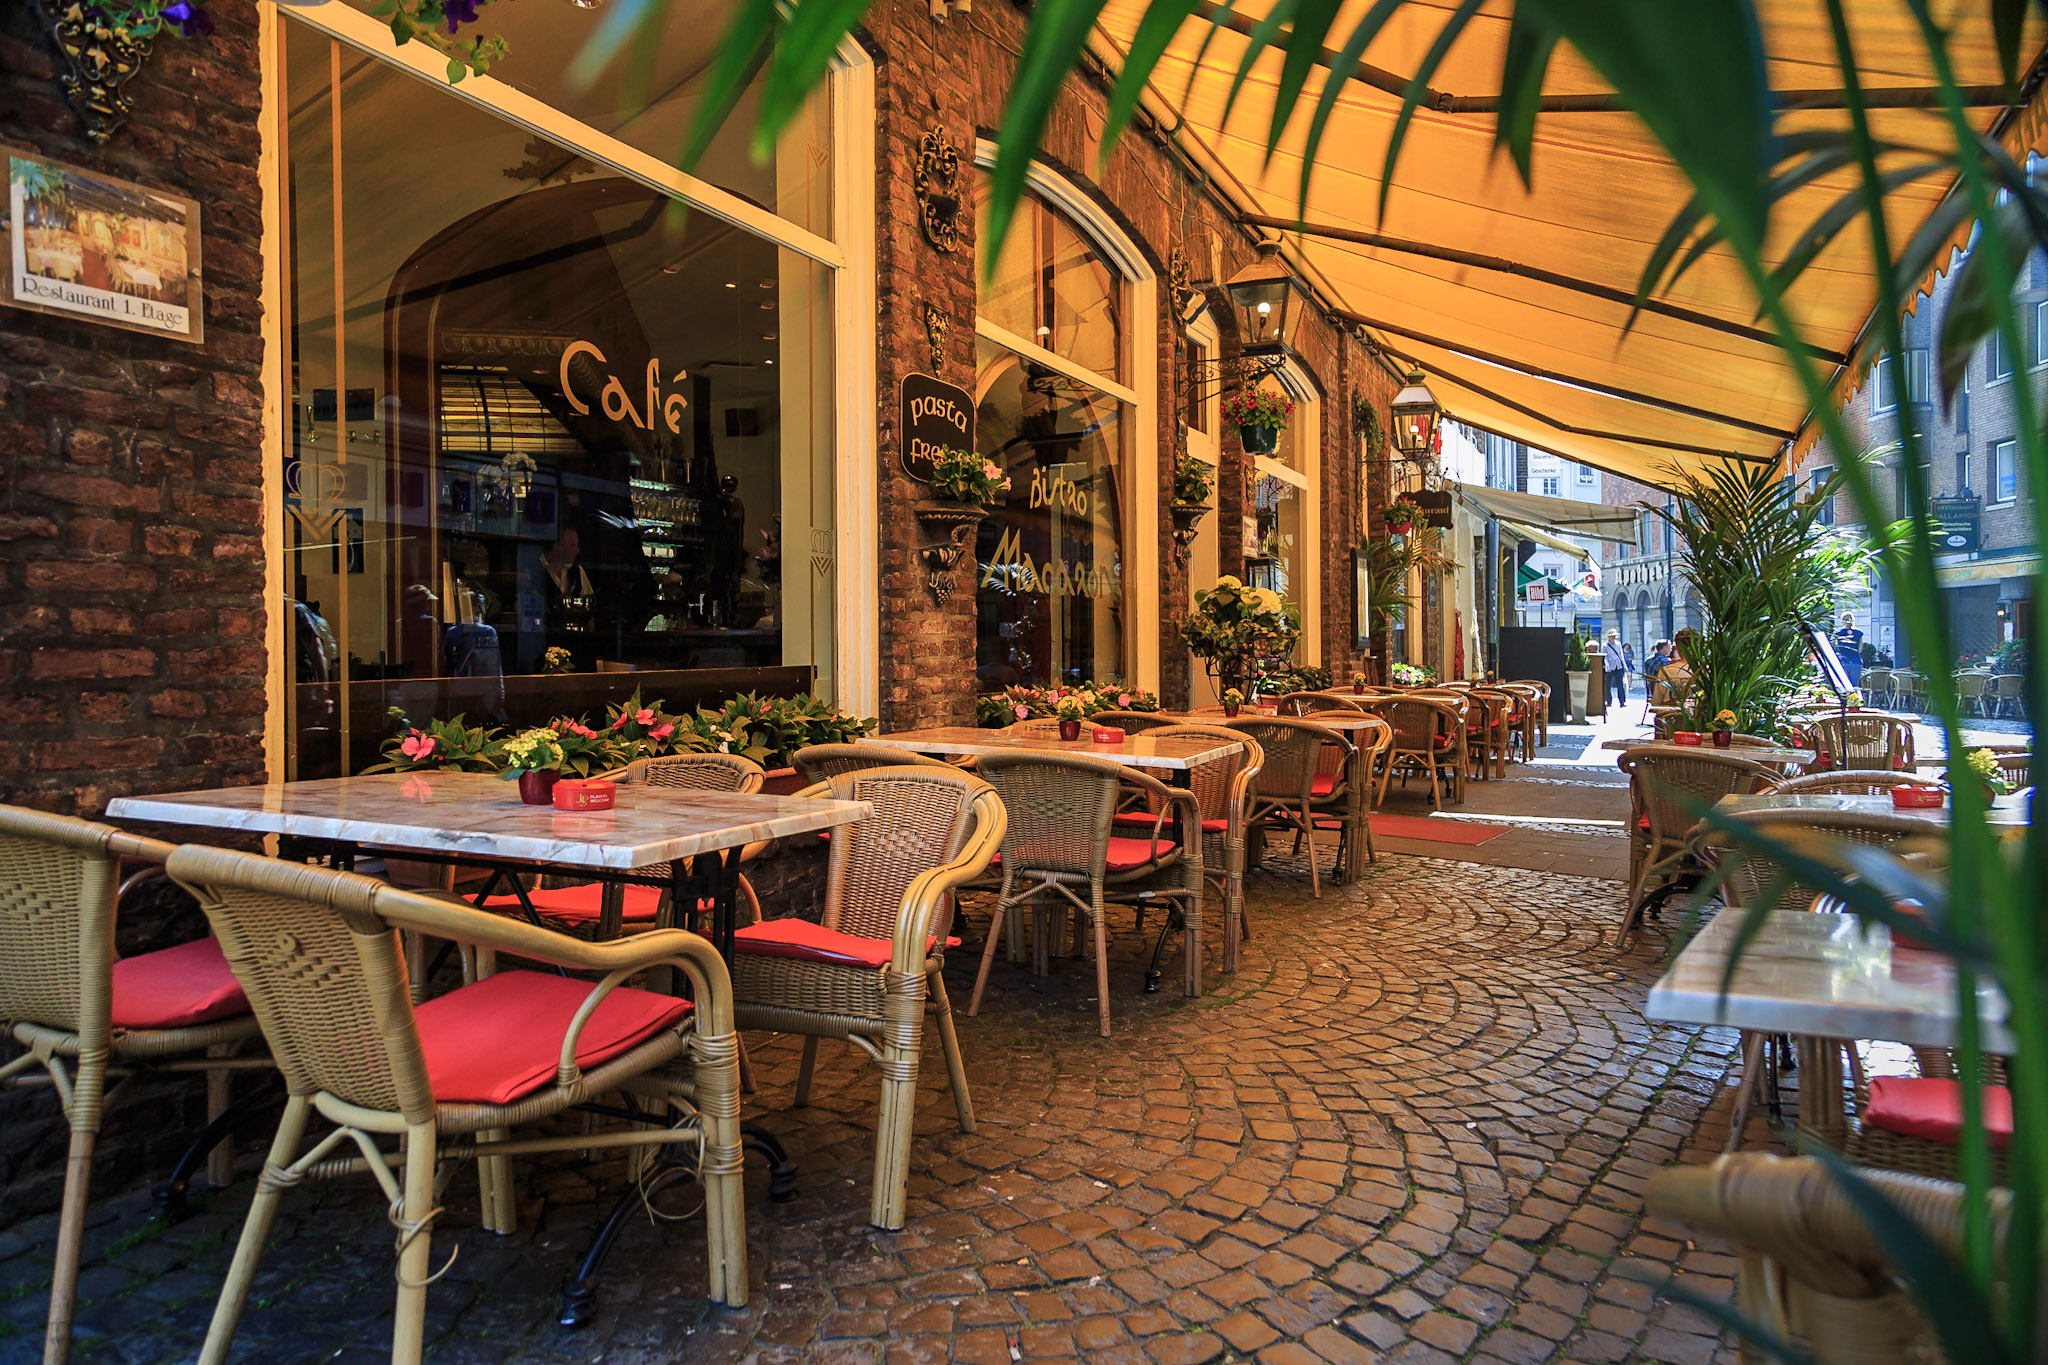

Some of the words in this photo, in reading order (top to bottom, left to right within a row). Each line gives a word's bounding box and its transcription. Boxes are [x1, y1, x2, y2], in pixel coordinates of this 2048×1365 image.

[22, 276, 117, 312] Restaurant
[124, 299, 135, 315] 1.
[142, 302, 183, 328] Etage
[560, 340, 688, 434] Café
[910, 396, 967, 433] pasta
[1030, 465, 1087, 516] Bistro
[980, 525, 1122, 599] Macaron
